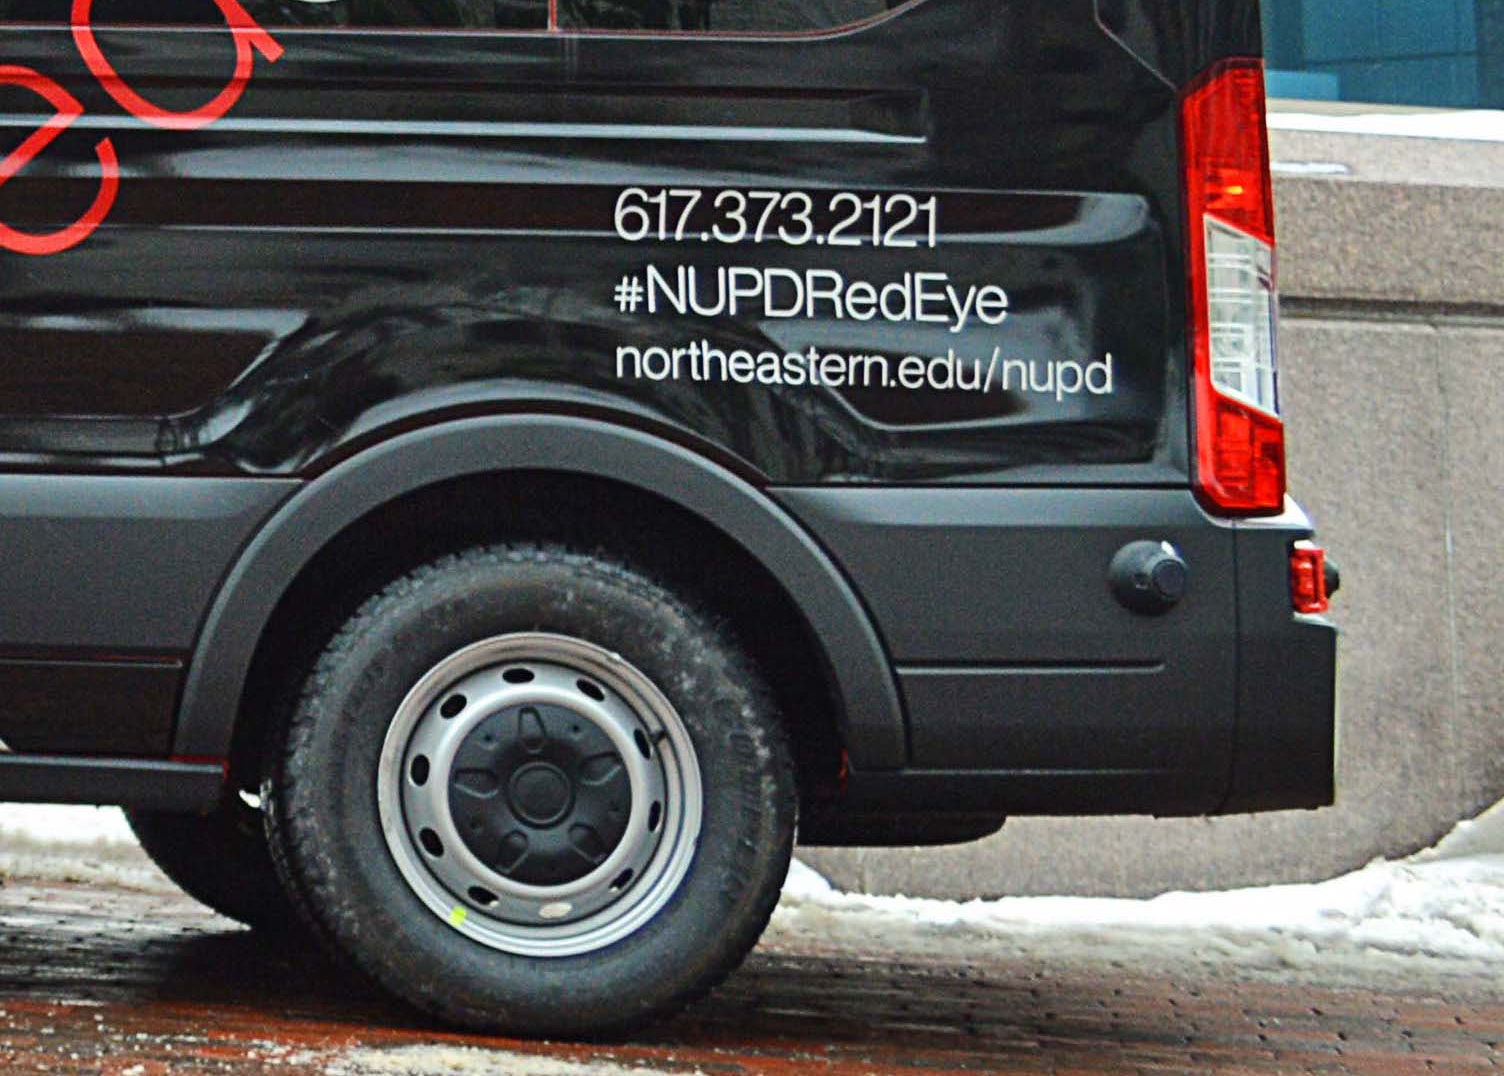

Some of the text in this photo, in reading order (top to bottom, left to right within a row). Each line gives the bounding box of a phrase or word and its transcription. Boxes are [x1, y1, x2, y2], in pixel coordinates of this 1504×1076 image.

[614, 187, 938, 247] 617.373.2121
[614, 264, 1009, 333] #NUPDRedEye
[615, 339, 1113, 401] northeastern.edu/nupd
